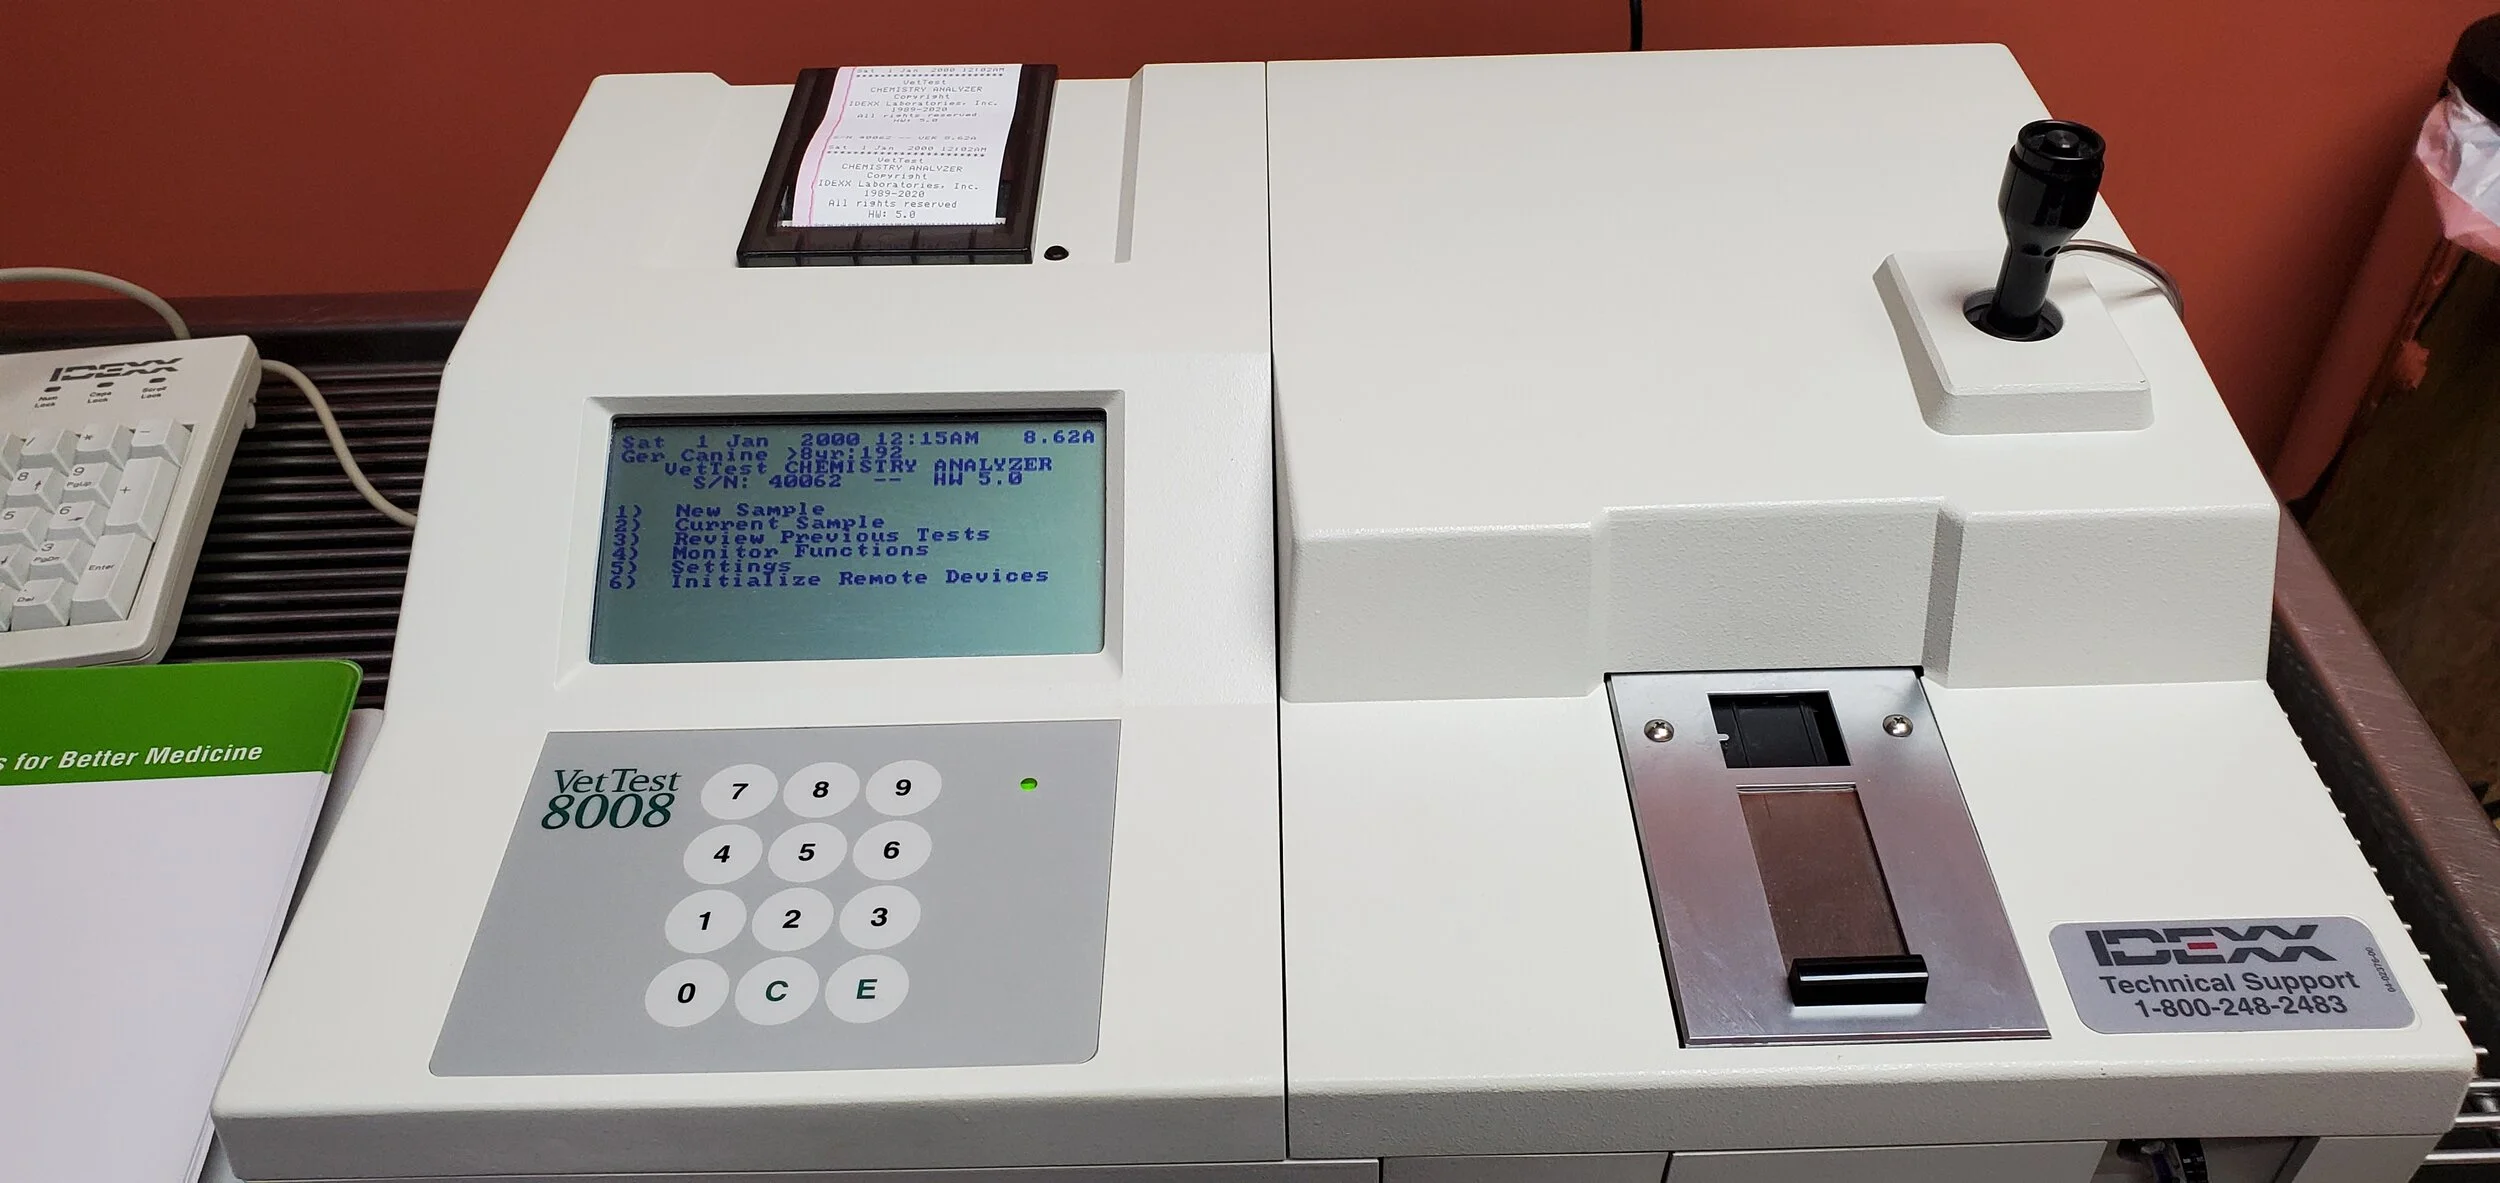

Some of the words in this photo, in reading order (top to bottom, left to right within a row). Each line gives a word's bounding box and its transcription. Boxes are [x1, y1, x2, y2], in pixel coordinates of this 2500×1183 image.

[841, 163, 902, 171] CHEMISTRY
[909, 165, 963, 173] ANALYZER
[867, 172, 928, 180] Copyright
[818, 180, 852, 188] IDEXX
[864, 190, 925, 198] 1989-2020
[828, 199, 848, 207] All
[856, 199, 896, 208] rights
[904, 200, 957, 208] reserved
[868, 210, 888, 219] HW:
[895, 210, 916, 219] 5.0
[49, 357, 184, 382] IDEXX
[621, 435, 665, 450] Sat
[697, 434, 708, 448] 1
[726, 434, 769, 448] Jan
[801, 432, 860, 447] 2000
[876, 430, 980, 446] 12:15AM
[1023, 430, 1095, 444] 8.62A
[620, 449, 666, 463] Ger
[680, 448, 768, 463] Canine
[787, 445, 903, 462] >8yr:192
[72, 466, 85, 476] 9
[665, 461, 768, 476] VetTest
[784, 458, 917, 474] CHEMISTRY
[933, 457, 1053, 472] ANALYZER
[17, 471, 29, 482] 8
[693, 475, 749, 490] S/N:
[768, 474, 842, 488] 40062
[933, 472, 963, 486] HW
[978, 471, 1023, 486] 5.0
[3, 510, 16, 520] 5
[58, 505, 72, 516] 6
[616, 504, 642, 519] 1)
[675, 503, 721, 518] New
[736, 501, 825, 518] Sample
[614, 518, 641, 533] 2)
[674, 517, 779, 532] Current
[796, 515, 885, 531] Sample
[613, 532, 640, 547] 3)
[673, 531, 765, 546] Review
[780, 529, 899, 545] Previous
[917, 526, 990, 542] Tests
[41, 543, 55, 552] 3
[612, 546, 638, 561] 4)
[672, 545, 778, 560] Monitor
[794, 542, 929, 558] Functions
[88, 563, 115, 571] Enter
[610, 560, 637, 575] 5)
[671, 558, 791, 574] Settings
[609, 574, 636, 590] 6)
[671, 571, 821, 589] Initialize
[838, 570, 928, 587] Remote
[945, 567, 1049, 584] Devices
[14, 752, 53, 771] for
[58, 750, 138, 769] Better
[144, 744, 263, 766] Medicine
[553, 768, 683, 794] VetTest
[812, 781, 830, 799] 8
[894, 779, 912, 797] 9
[731, 782, 749, 800] 7
[541, 792, 675, 830] 8008
[713, 845, 731, 863] 4
[797, 843, 816, 862] 5
[882, 841, 901, 859] 6
[698, 911, 712, 930] 1
[782, 909, 801, 928] 2
[870, 908, 889, 927] 3
[2085, 924, 2337, 967] IDEXX
[765, 980, 789, 1002] C
[856, 978, 878, 999] E
[2098, 973, 2237, 995] Technical
[2241, 970, 2361, 994] Support
[677, 982, 696, 1003] 0
[2133, 994, 2349, 1018] 1-800-248-2483
